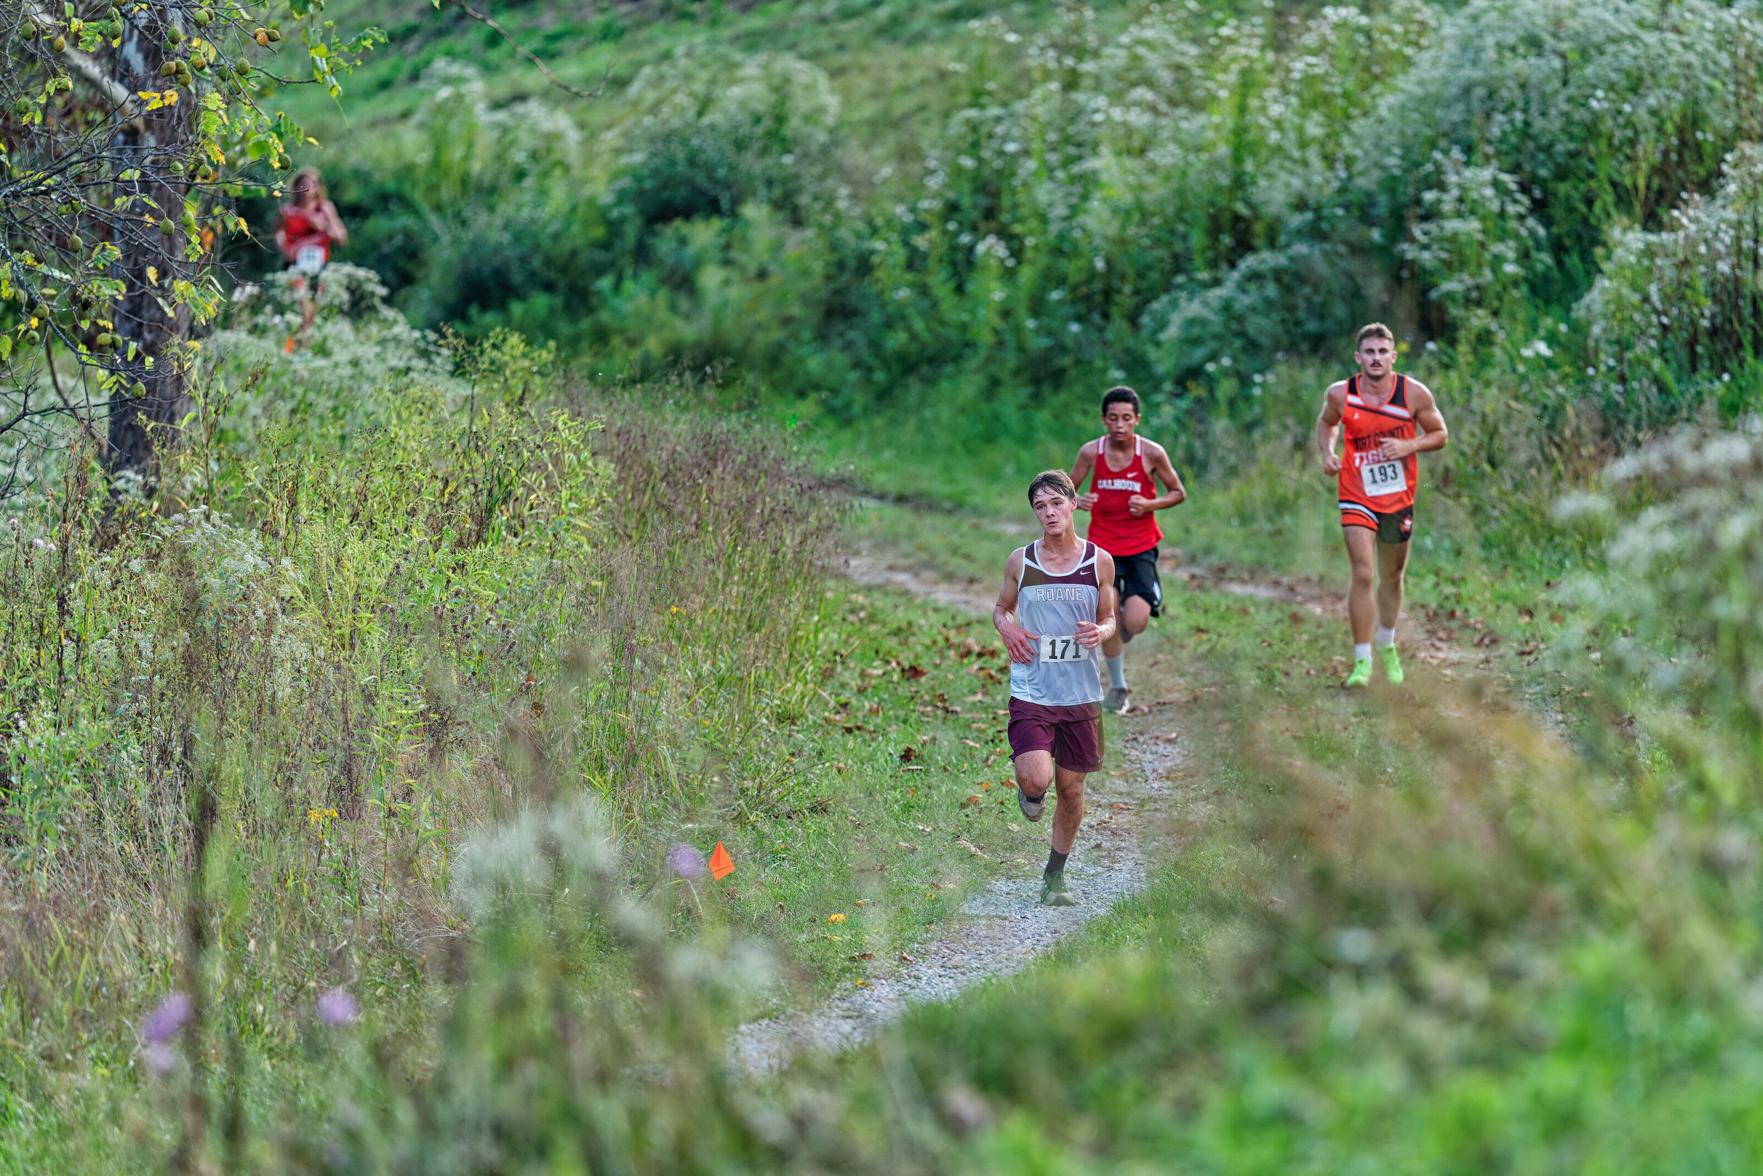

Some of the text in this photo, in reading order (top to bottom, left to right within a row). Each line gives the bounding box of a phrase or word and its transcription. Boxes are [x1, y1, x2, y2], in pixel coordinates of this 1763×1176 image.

[1369, 463, 1398, 485] 193
[1036, 587, 1084, 602] ROANE
[1048, 639, 1081, 660] 171
